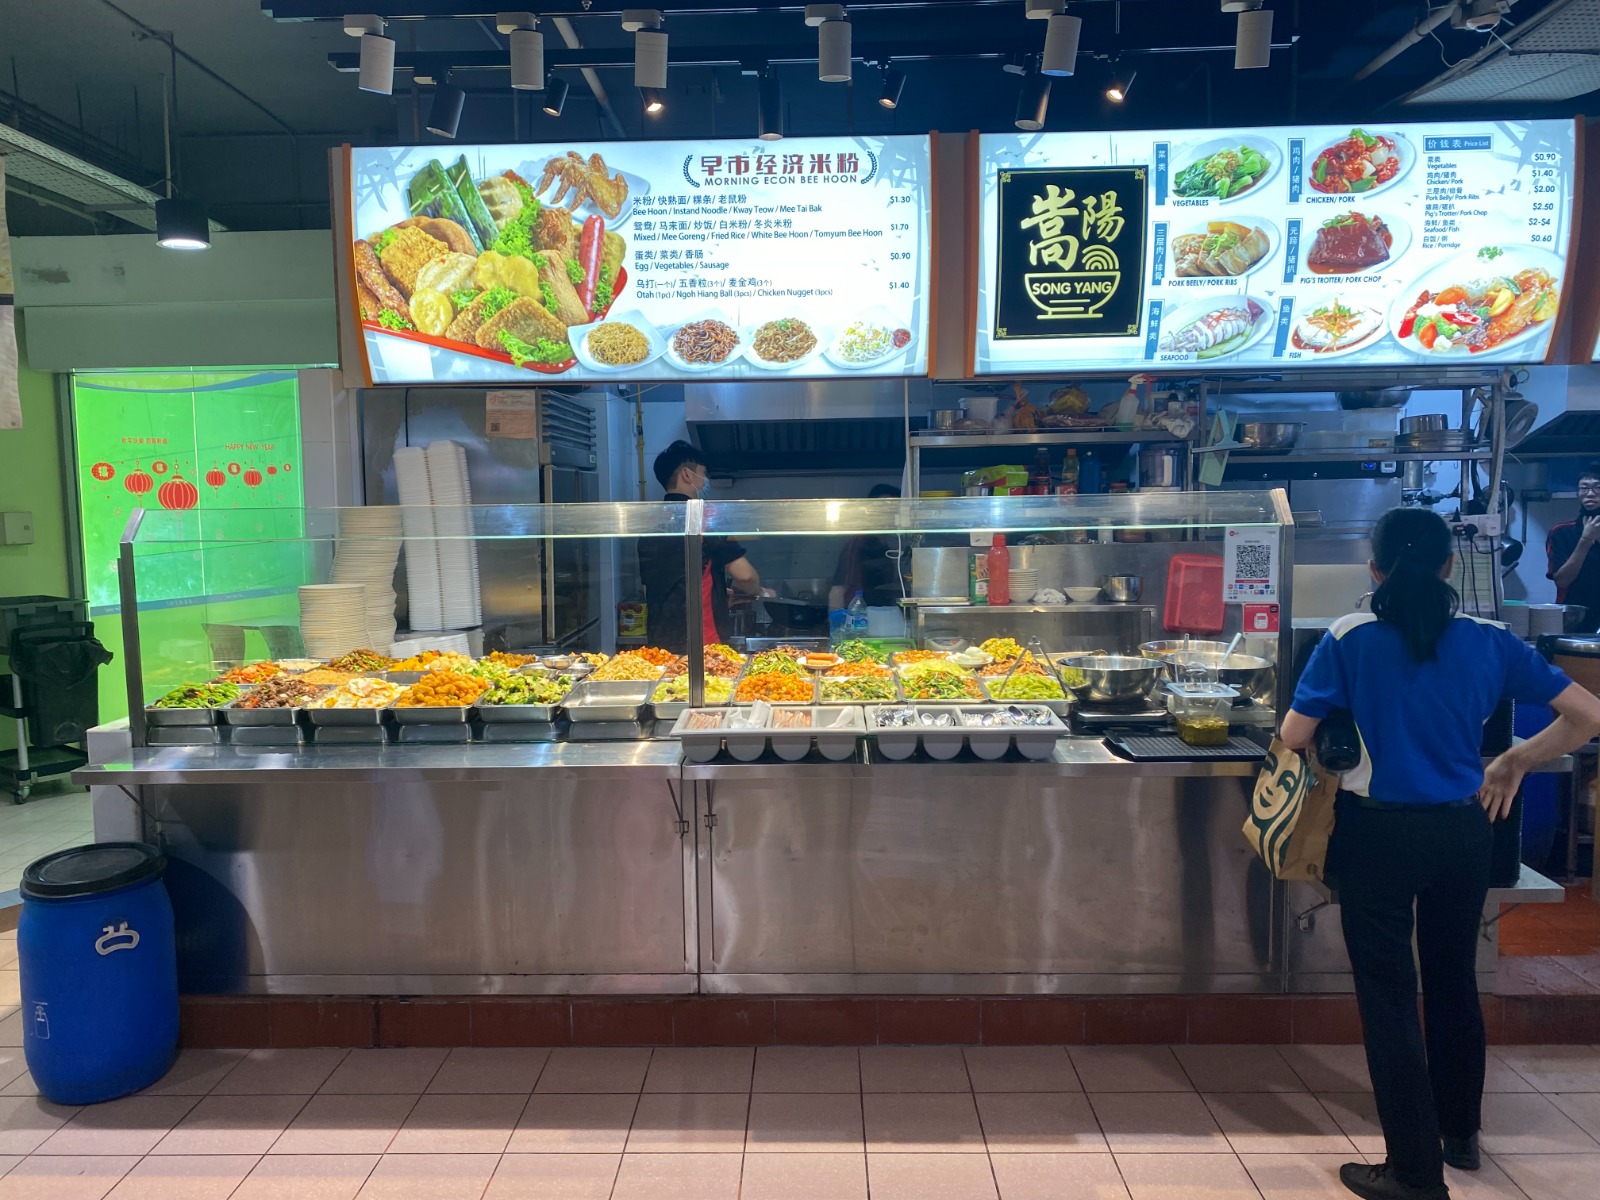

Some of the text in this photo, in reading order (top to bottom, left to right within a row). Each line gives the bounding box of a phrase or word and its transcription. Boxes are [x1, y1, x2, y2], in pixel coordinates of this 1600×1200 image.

[1427, 139, 1461, 148] 价钱表
[1534, 153, 1556, 161] $0.90
[701, 153, 859, 176] 早市经济米粉
[1532, 169, 1553, 177] $1.40
[704, 174, 857, 186] MORNING ECON BEE HOON
[1533, 185, 1555, 193] $2.00
[718, 194, 746, 204] 老鼠粉
[701, 206, 727, 214] Noodle
[733, 206, 752, 215] Kway
[809, 204, 822, 212] Bak
[1532, 203, 1553, 211] $2.50
[754, 219, 792, 228] 冬炎米粉
[1528, 218, 1550, 226] $2-$4
[891, 223, 908, 231] $1.70
[678, 232, 705, 241] Goreng
[751, 231, 772, 239] White
[814, 230, 846, 239] Tomyum
[1531, 234, 1552, 242] $0.60
[685, 249, 703, 259] 香肠
[890, 252, 910, 260] $0.90
[635, 262, 648, 271] Egg
[654, 261, 693, 270] Vegetables
[699, 261, 729, 270] Sausage
[1032, 281, 1111, 294] SONG YANG
[637, 290, 654, 298] Otah
[656, 291, 670, 299] (1pc)
[676, 290, 695, 299] Ngoh
[697, 290, 718, 298] Hiang
[720, 289, 732, 297] Ball
[734, 290, 751, 298] (3pcs)
[787, 289, 813, 297] Nugget
[815, 288, 832, 296] (3pcs)
